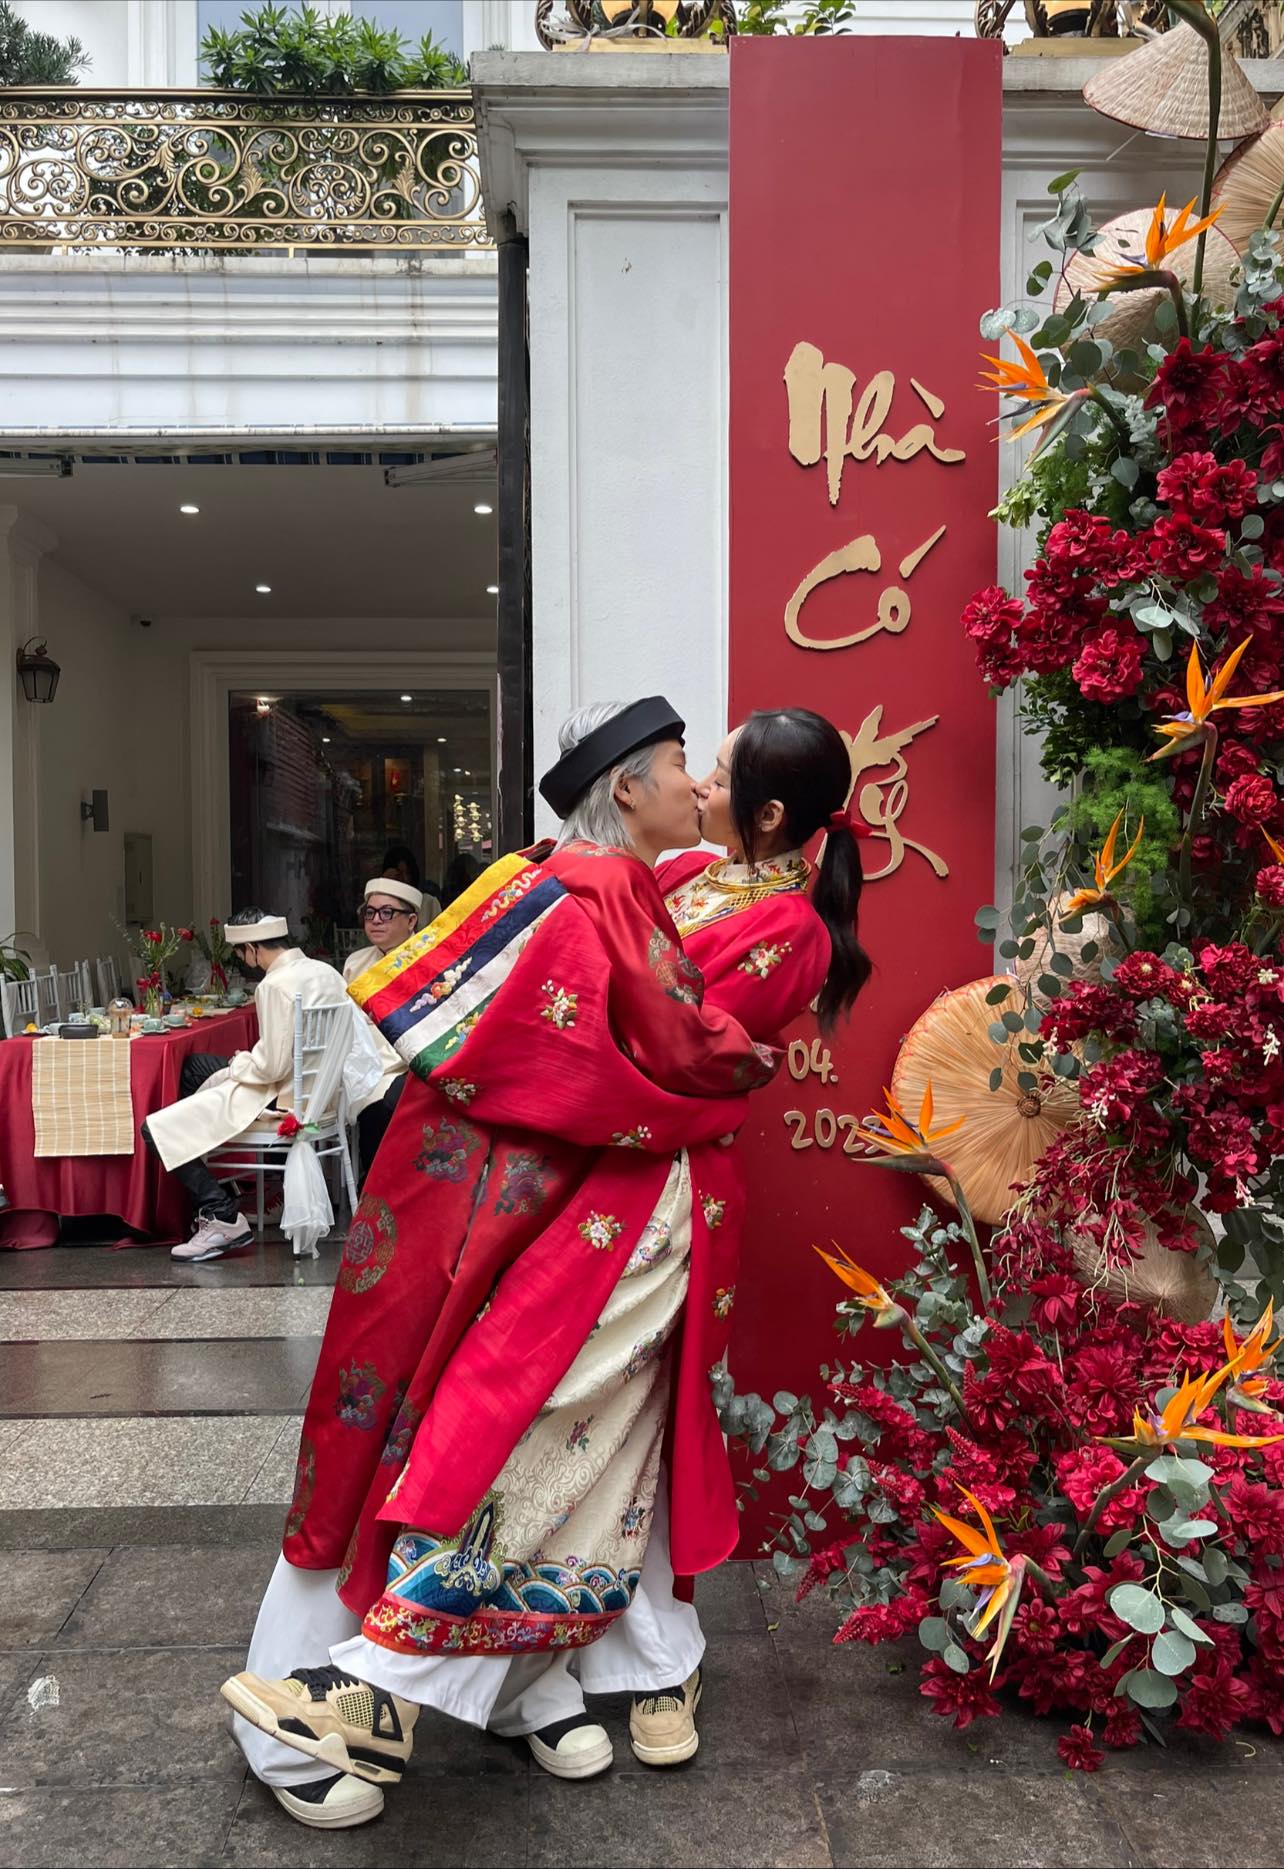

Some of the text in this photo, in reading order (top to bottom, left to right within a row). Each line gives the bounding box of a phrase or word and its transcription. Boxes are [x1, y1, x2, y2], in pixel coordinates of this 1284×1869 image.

[783, 341, 967, 506] Nhà
[784, 524, 947, 650] Có
[787, 1038, 839, 1084] 04.
